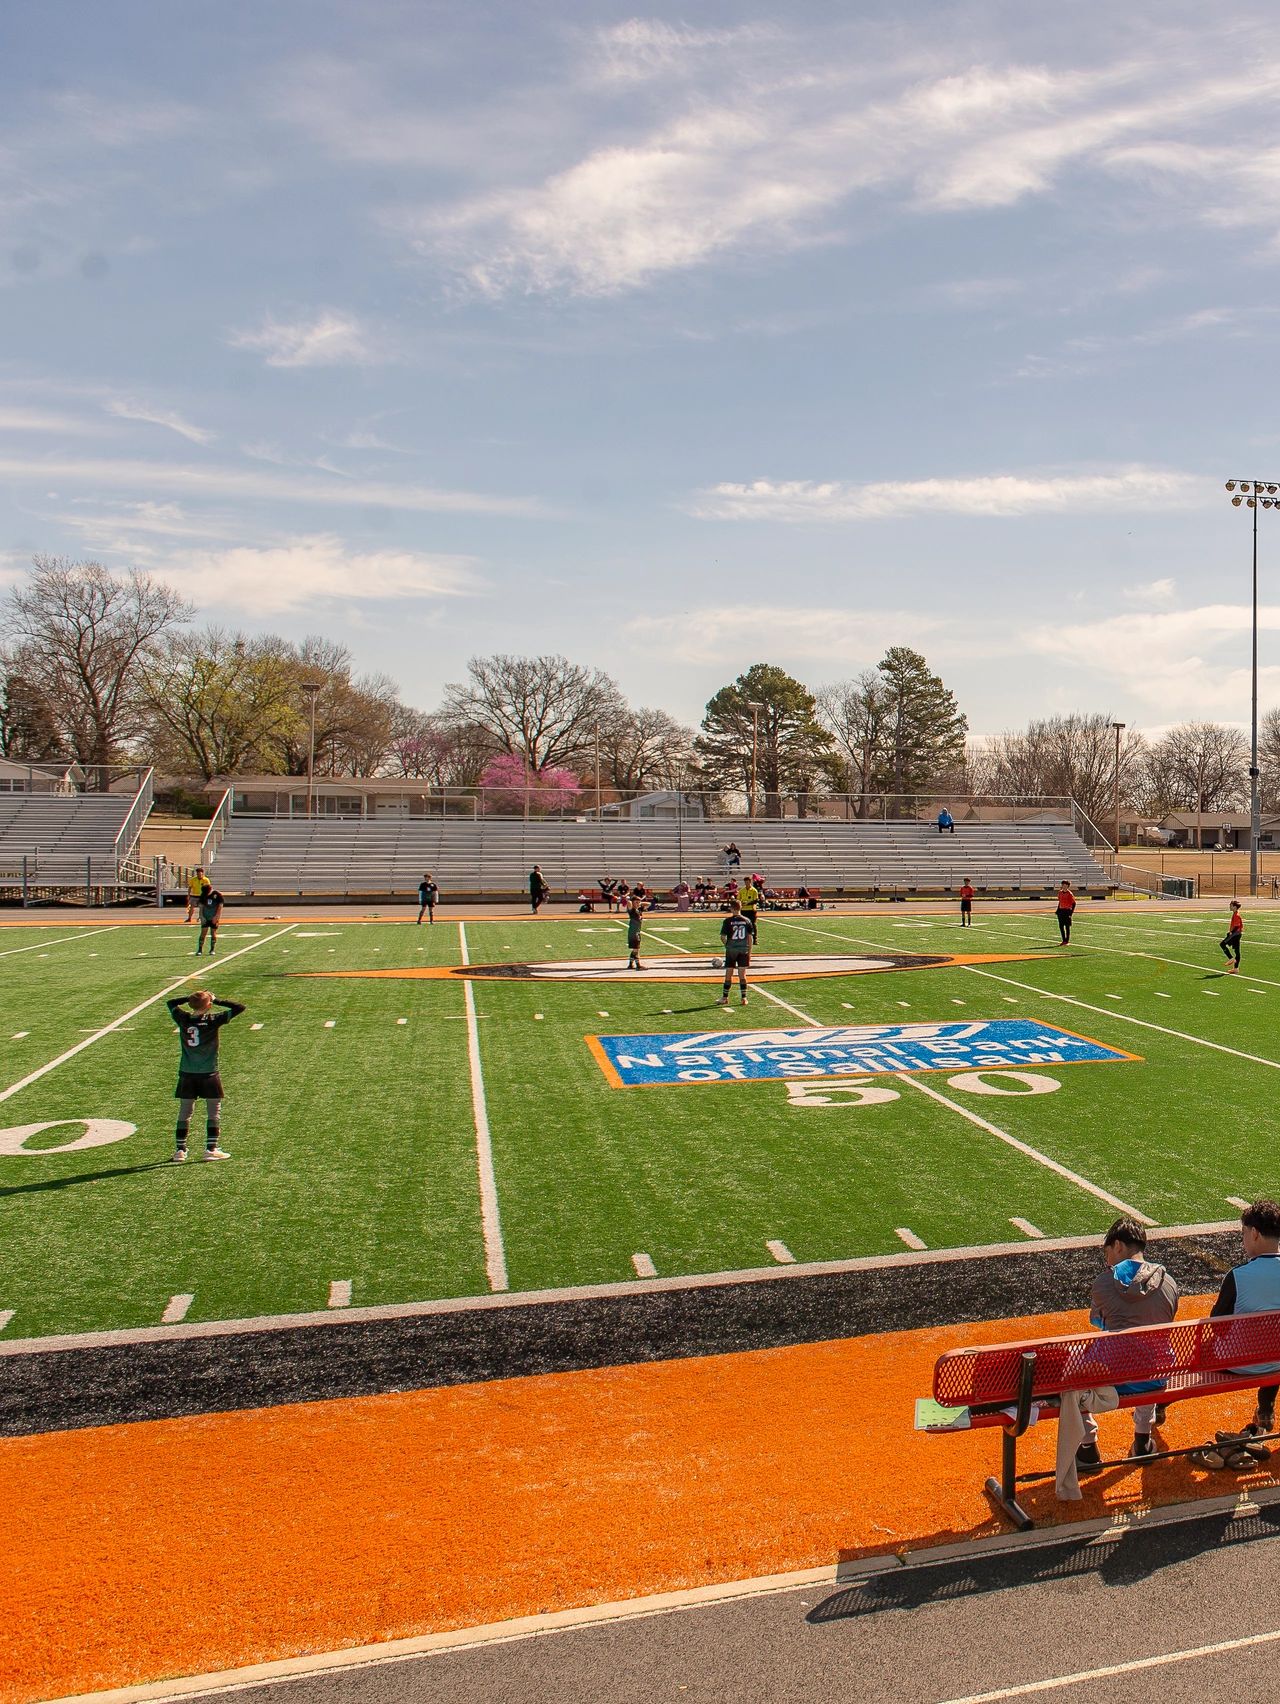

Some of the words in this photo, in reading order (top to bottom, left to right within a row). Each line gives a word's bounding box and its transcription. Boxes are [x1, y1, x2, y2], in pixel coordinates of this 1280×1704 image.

[731, 925, 746, 940] 20
[187, 1026, 200, 1047] 3
[616, 1043, 906, 1069] National
[917, 1036, 1087, 1053] Bank
[678, 1064, 748, 1081] of
[777, 1051, 1065, 1076] Sallisaw
